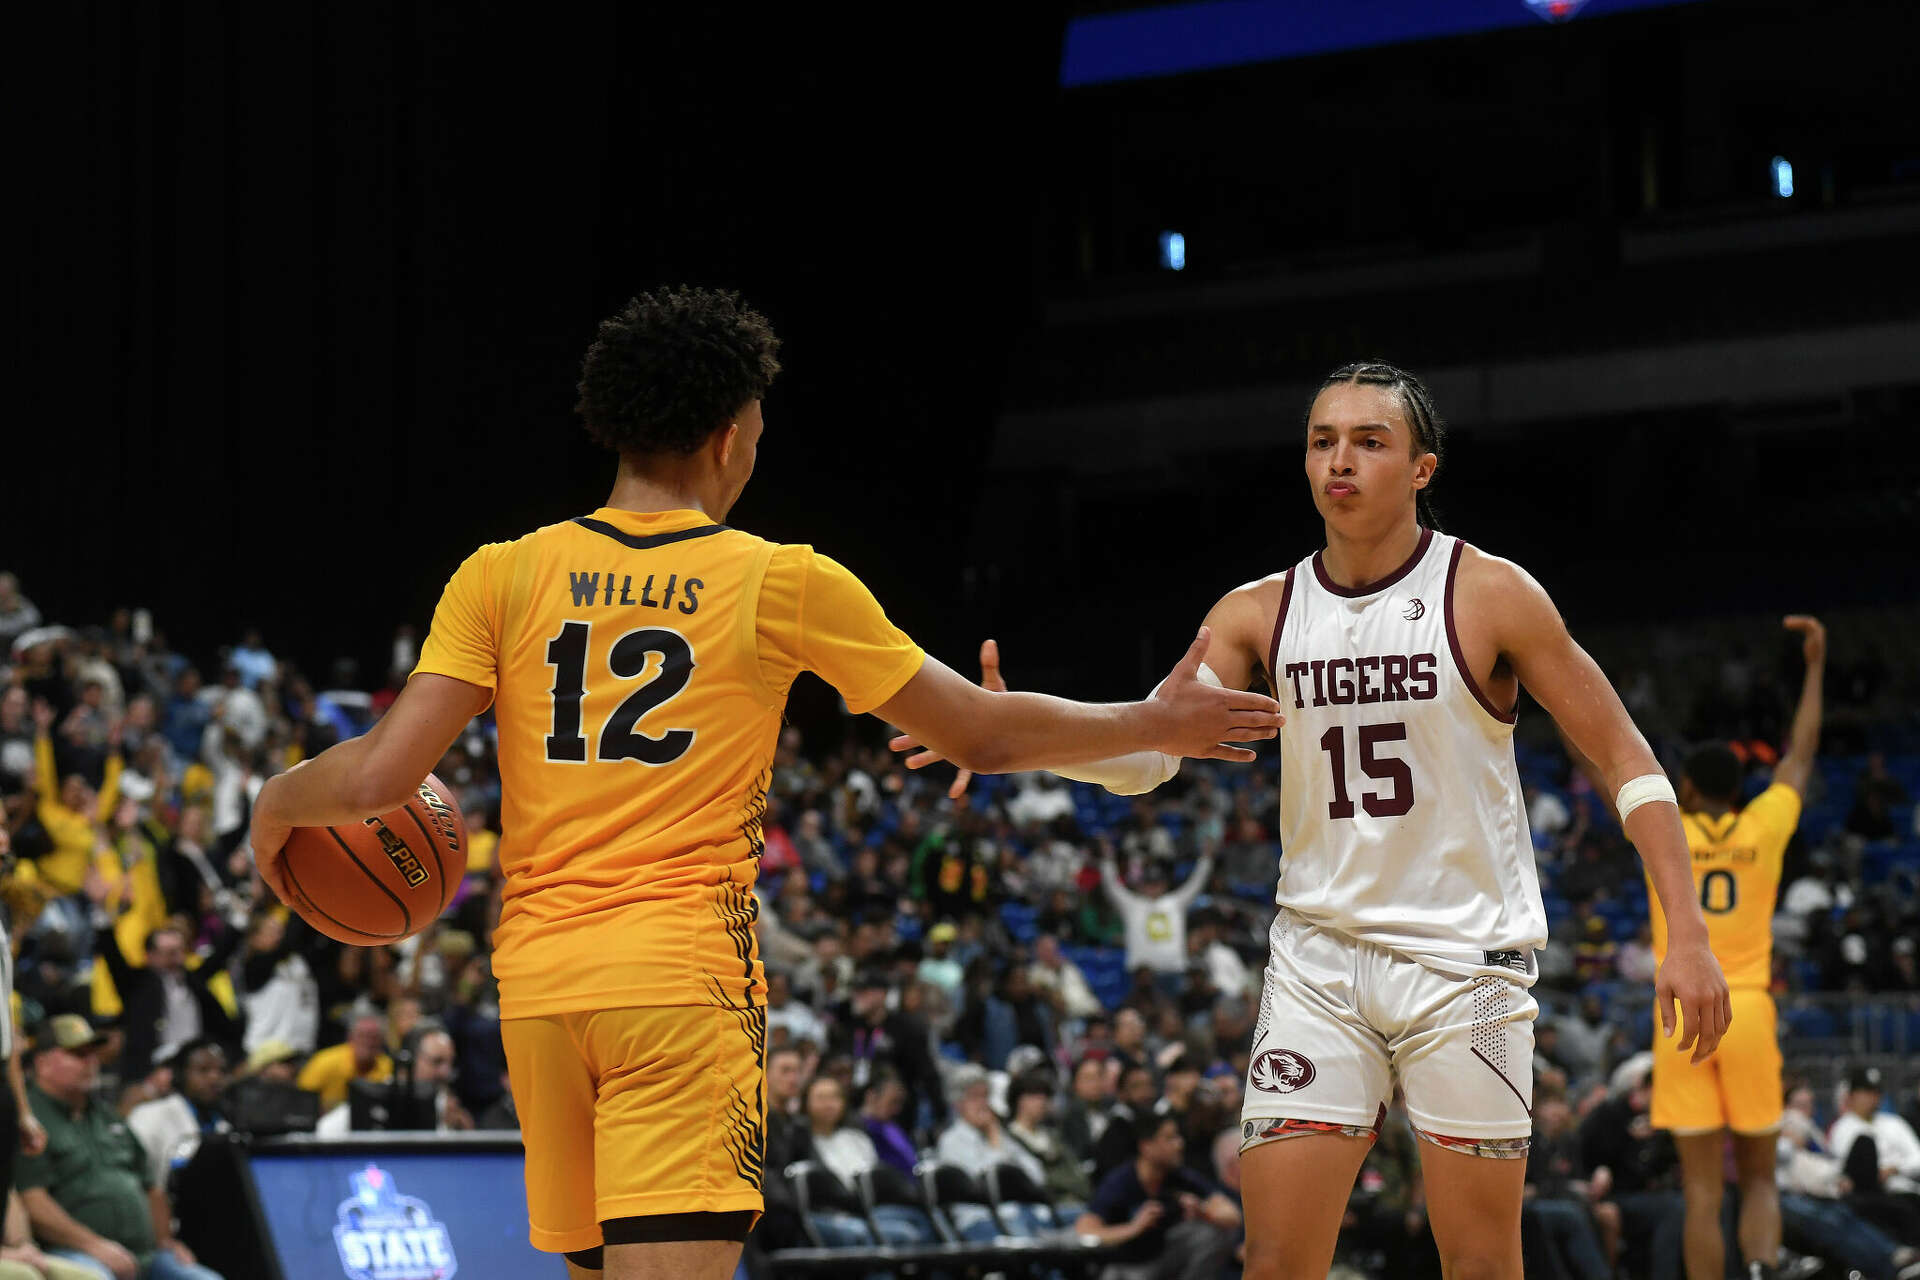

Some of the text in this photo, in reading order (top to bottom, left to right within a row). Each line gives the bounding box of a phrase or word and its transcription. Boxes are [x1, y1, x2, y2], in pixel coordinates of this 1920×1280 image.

[569, 571, 704, 615] WILLIS
[544, 619, 699, 767] 12
[1285, 652, 1438, 709] TIGERS
[1320, 722, 1415, 820] 15
[391, 846, 427, 885] PRO
[1700, 867, 1737, 914] 0
[341, 1226, 450, 1270] STATE
